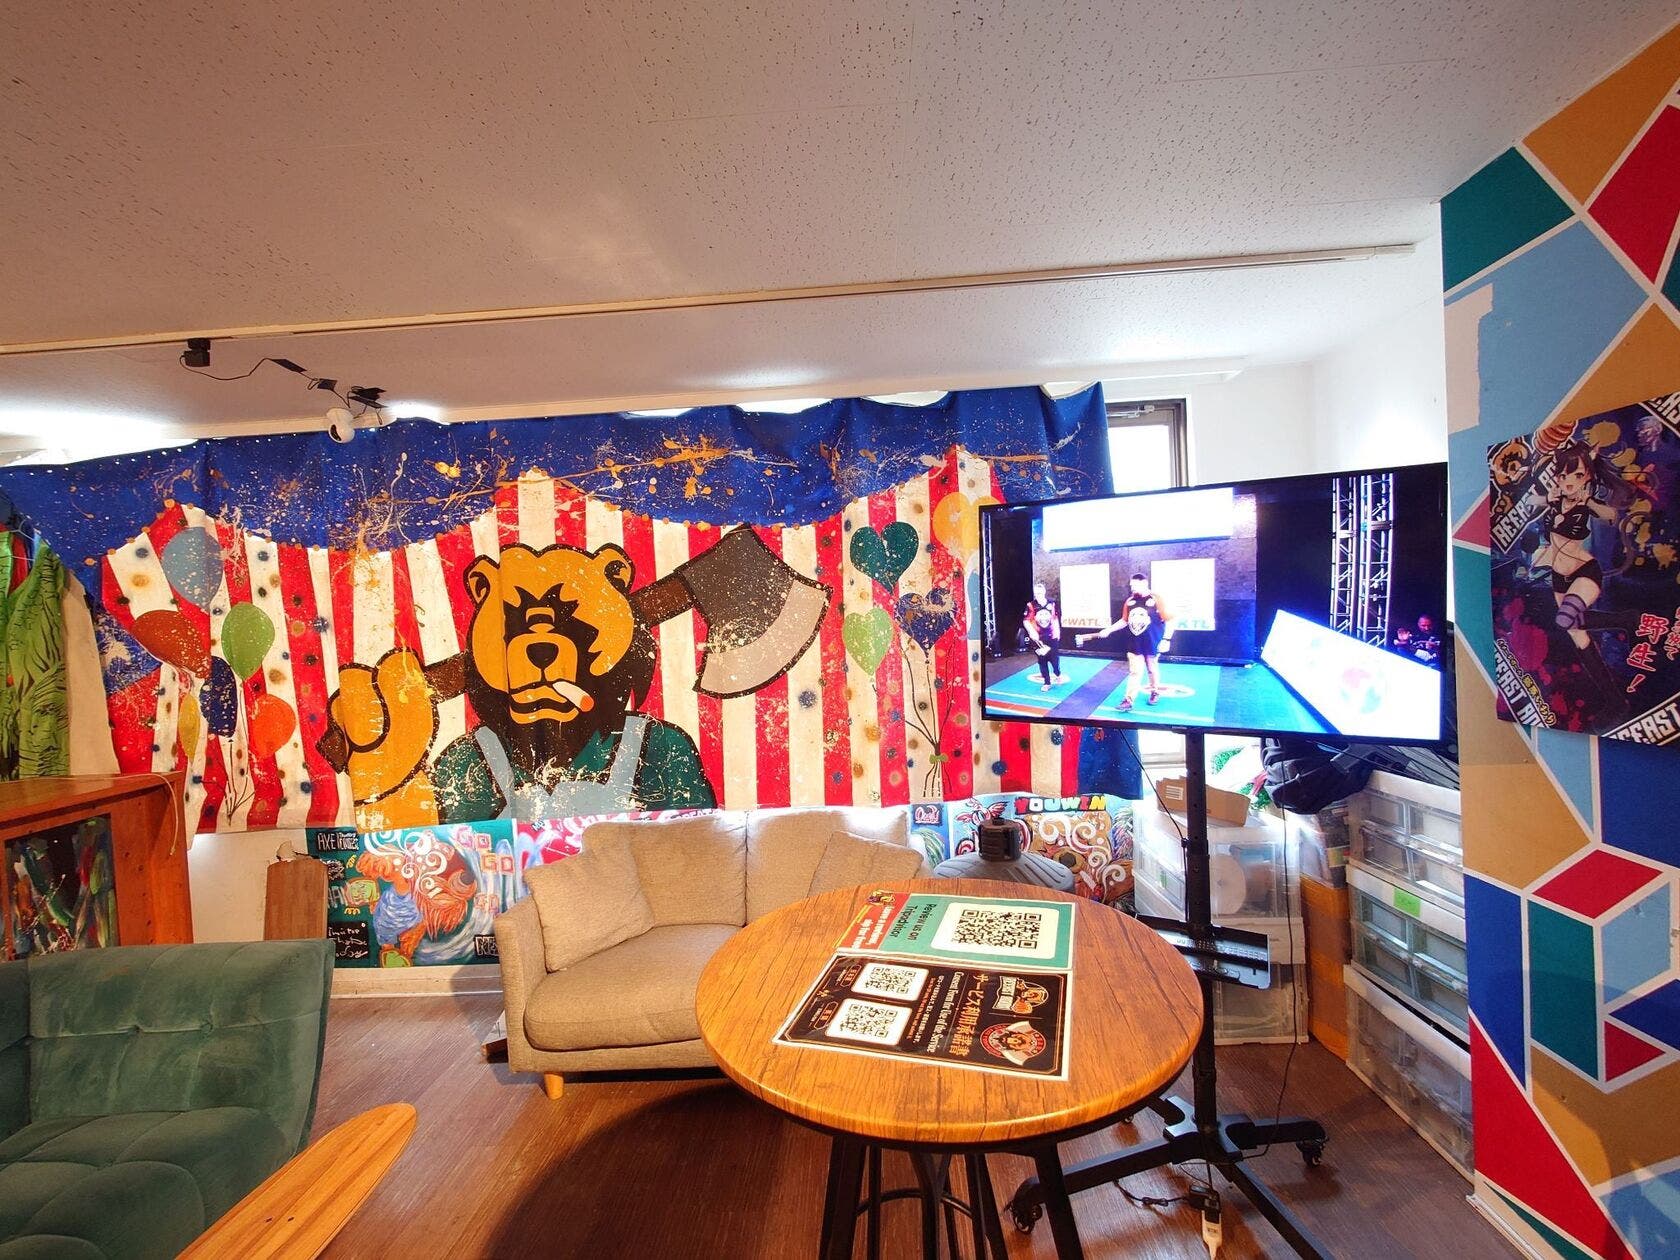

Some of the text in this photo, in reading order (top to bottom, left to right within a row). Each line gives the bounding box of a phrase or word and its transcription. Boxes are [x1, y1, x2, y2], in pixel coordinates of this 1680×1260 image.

[317, 831, 336, 850] AXE
[907, 904, 937, 940] Review us on
[949, 971, 965, 990] Consent
[945, 989, 959, 1002] Form
[938, 1009, 952, 1019] Use
[942, 1002, 954, 1010] for
[949, 973, 989, 1056] サービス利用承諾書
[933, 1025, 946, 1033] the
[926, 1033, 943, 1053] Service
